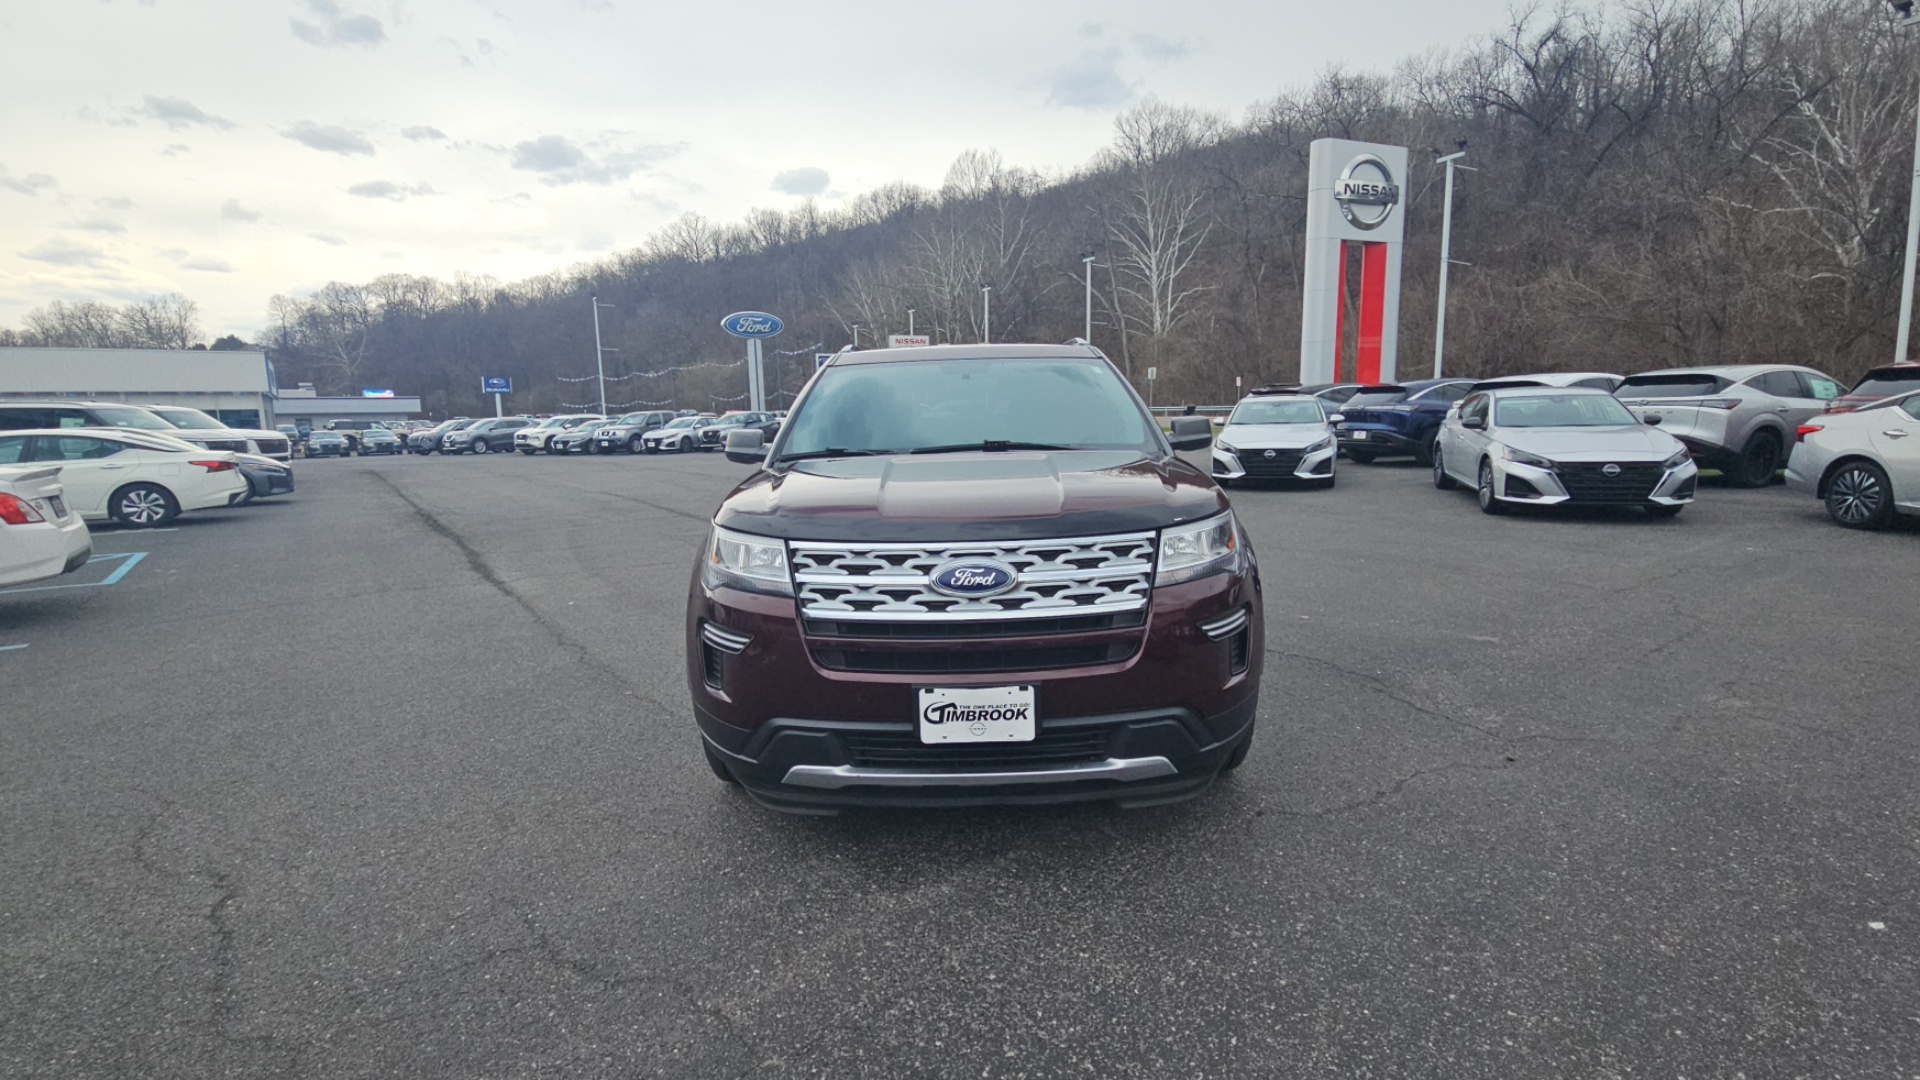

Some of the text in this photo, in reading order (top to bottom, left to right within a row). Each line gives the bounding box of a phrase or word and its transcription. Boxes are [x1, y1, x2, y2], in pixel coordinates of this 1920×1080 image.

[1344, 183, 1395, 199] NISSAN
[737, 317, 771, 332] Ford
[950, 568, 996, 586] Ford
